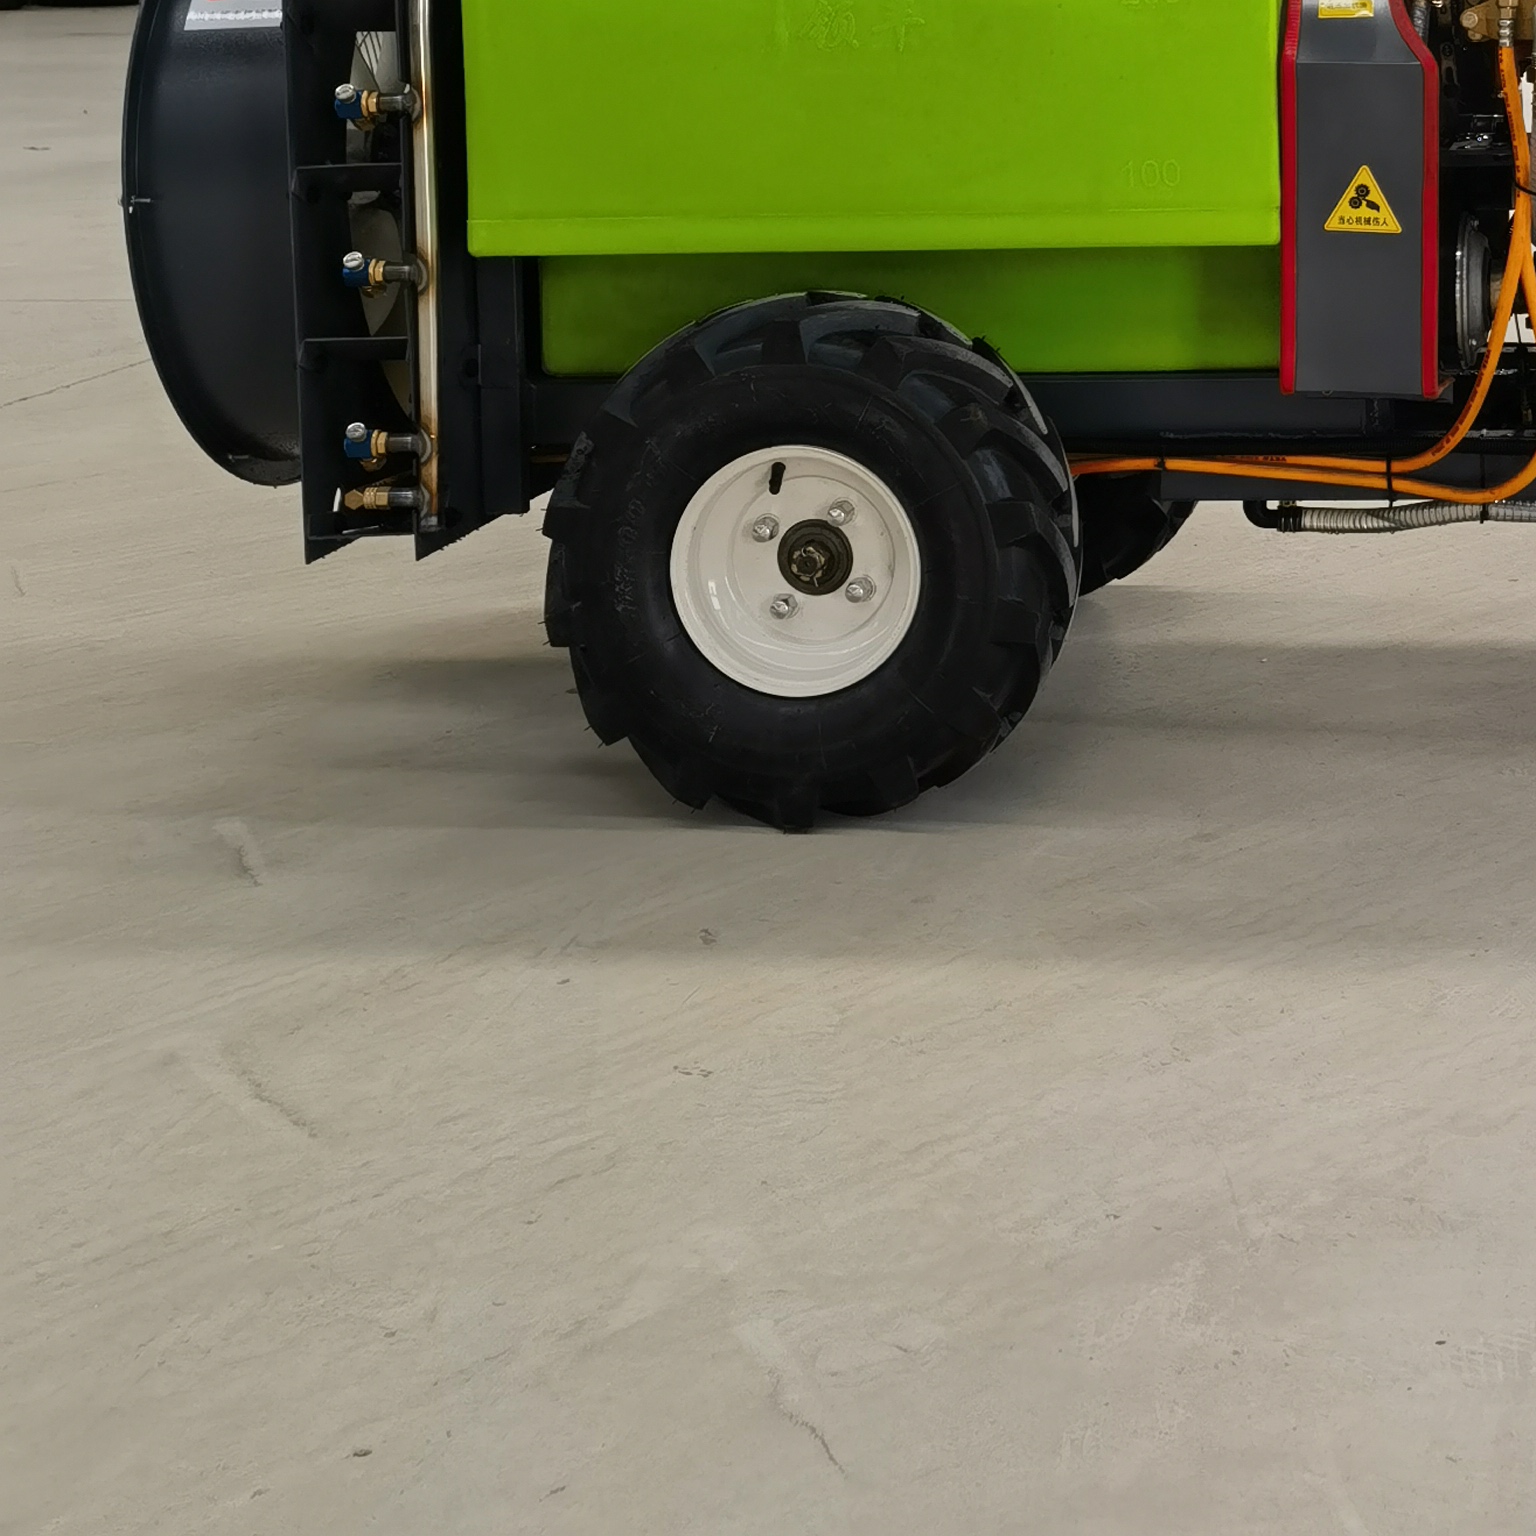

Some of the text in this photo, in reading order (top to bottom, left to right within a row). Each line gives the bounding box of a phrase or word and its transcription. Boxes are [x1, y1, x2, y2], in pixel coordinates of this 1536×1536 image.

[1122, 159, 1181, 188] 100
[1338, 215, 1389, 227] 当心机械伤人
